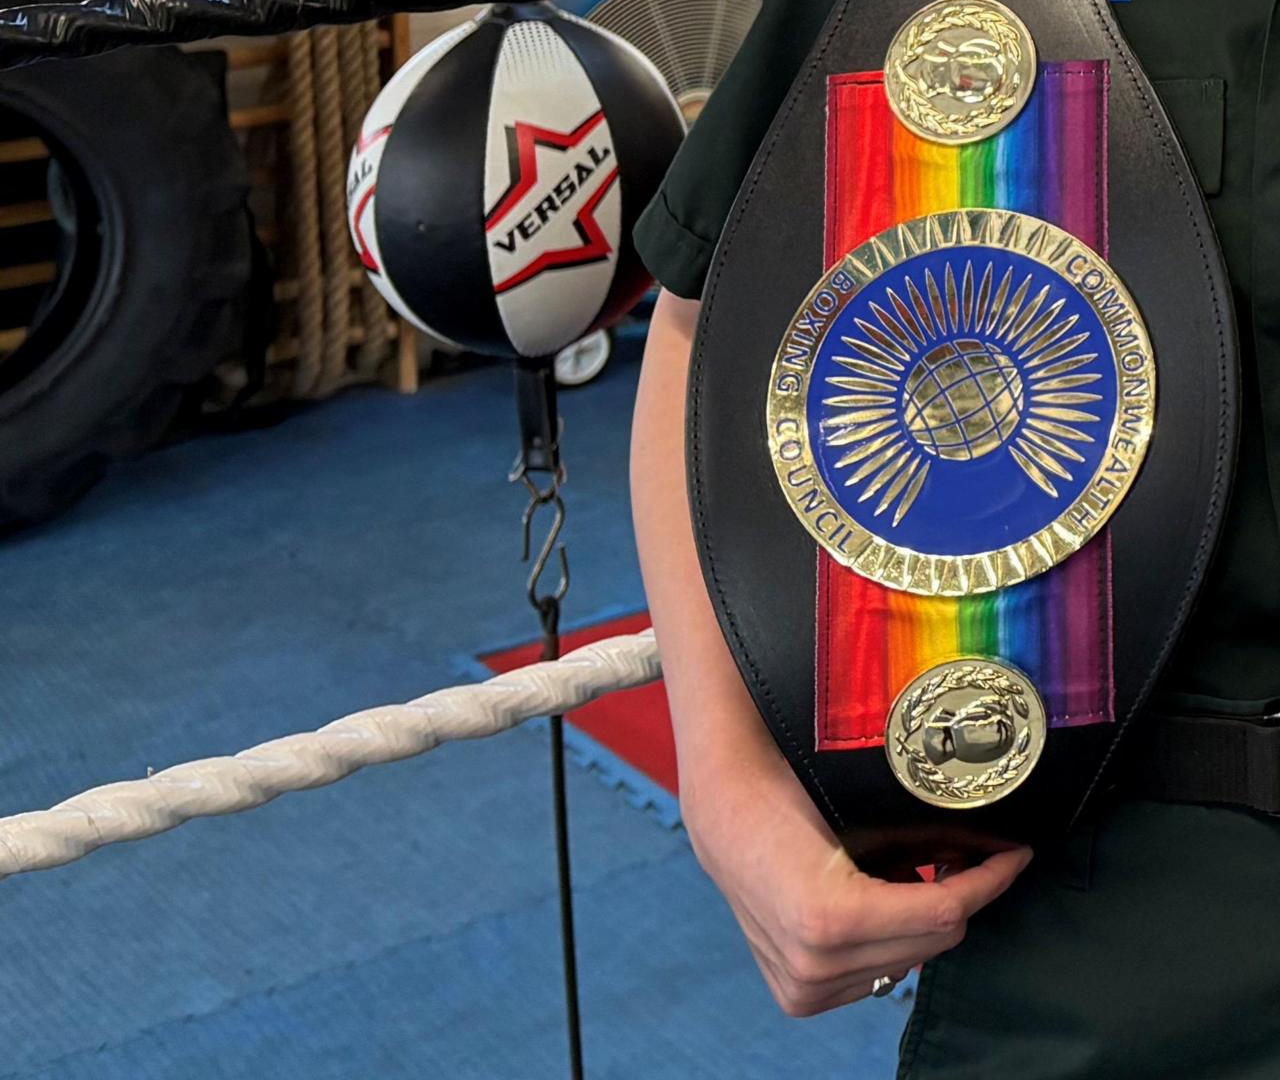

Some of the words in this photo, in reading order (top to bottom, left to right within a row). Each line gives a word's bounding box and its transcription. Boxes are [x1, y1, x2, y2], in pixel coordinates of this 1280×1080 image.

[493, 142, 611, 254] VERSAL
[775, 269, 857, 397] BOXING
[1065, 254, 1150, 534] COMMONWEALTH
[776, 417, 854, 555] COUNCIL
